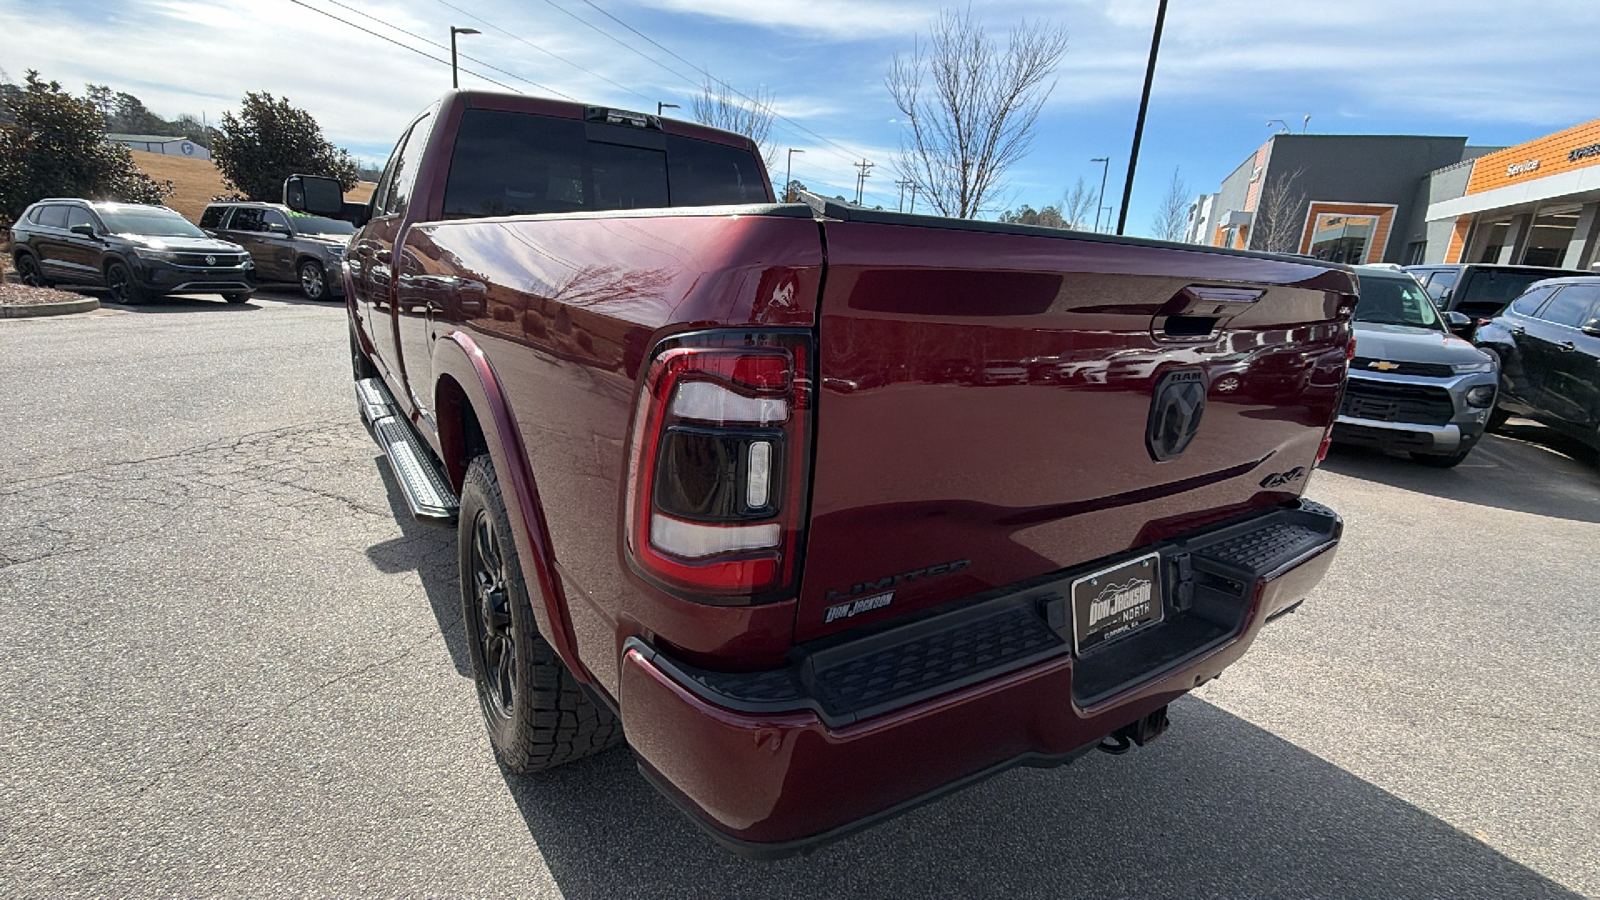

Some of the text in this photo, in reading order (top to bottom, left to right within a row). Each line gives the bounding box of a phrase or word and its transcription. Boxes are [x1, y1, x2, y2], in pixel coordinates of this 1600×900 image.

[1506, 159, 1541, 176] Service
[1171, 372, 1202, 381] RAM
[825, 559, 972, 601] LIMITED
[825, 592, 895, 624] DON JACKSON
[1089, 583, 1152, 626] DON JACKSON
[1122, 602, 1150, 623] NORTH
